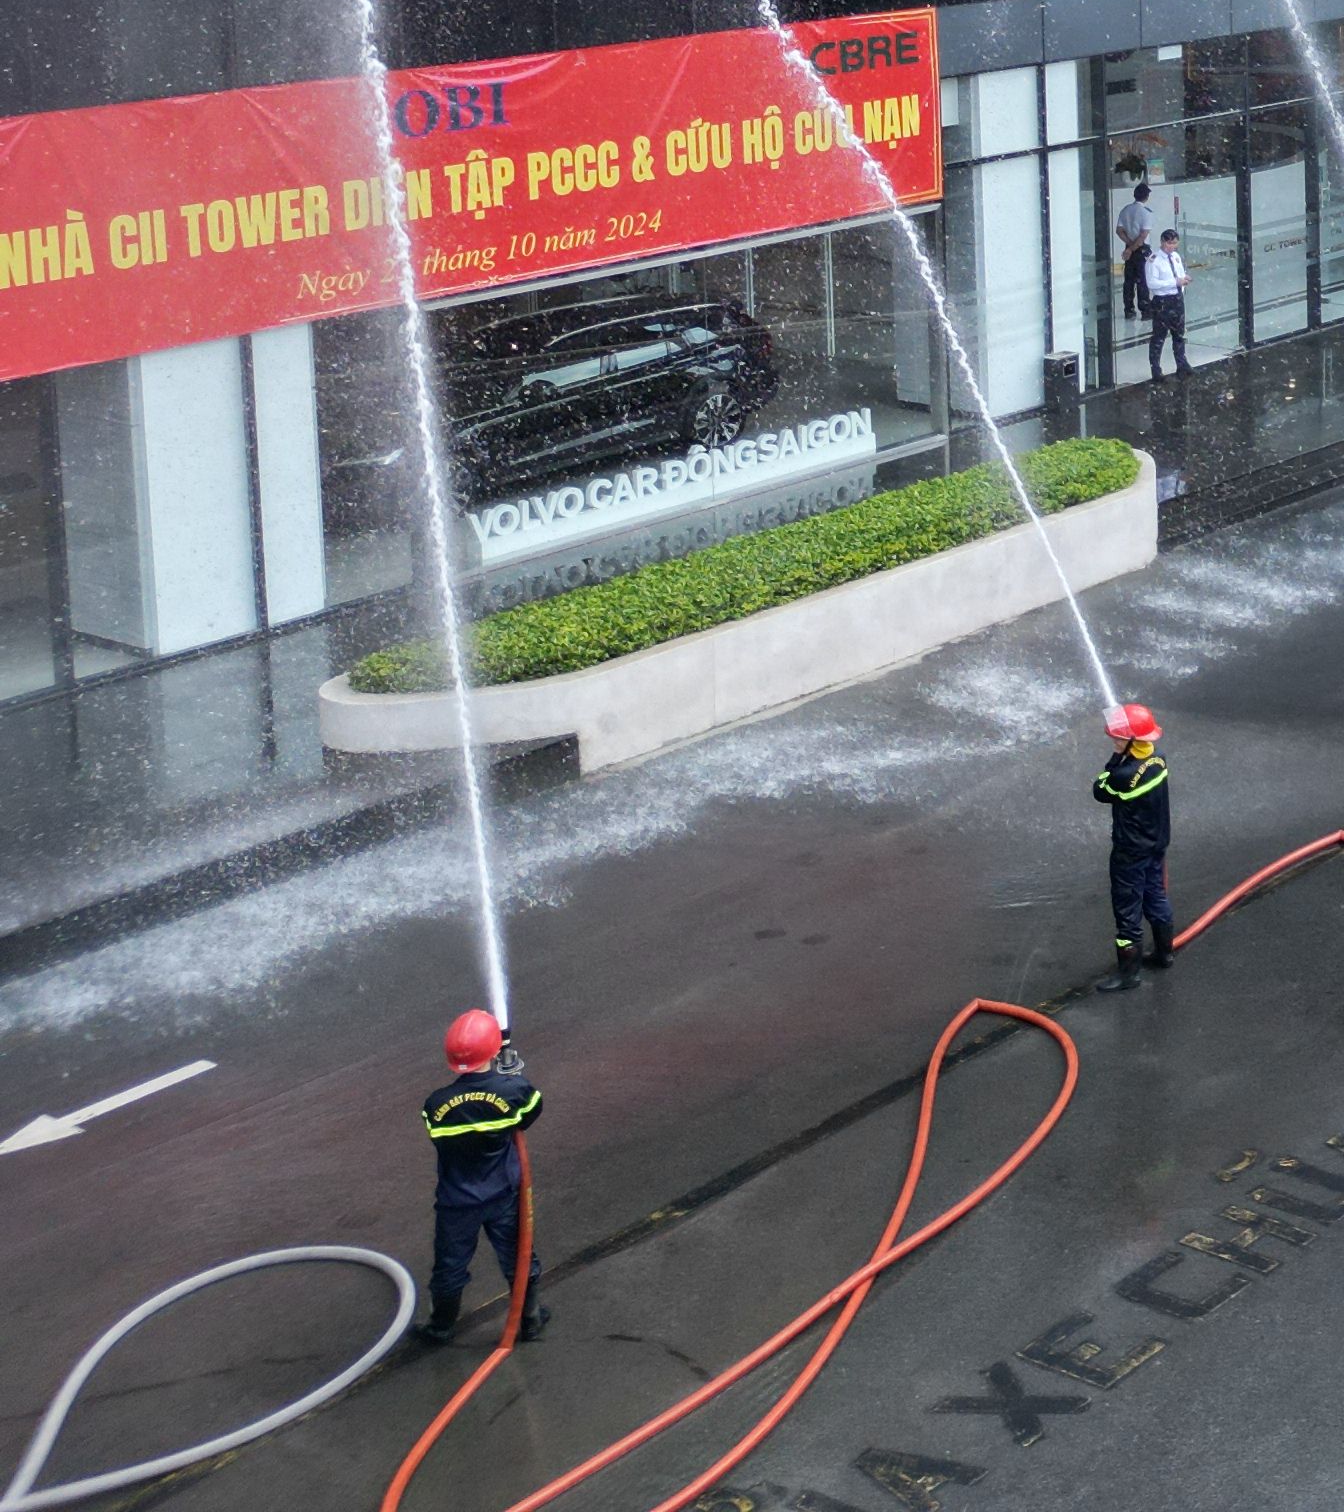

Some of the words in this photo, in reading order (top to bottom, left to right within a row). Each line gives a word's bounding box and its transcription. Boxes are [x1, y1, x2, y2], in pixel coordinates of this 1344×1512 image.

[811, 32, 919, 76] CBRE
[0, 208, 95, 288] NHÀ
[109, 209, 168, 269] CII
[180, 185, 330, 259] TOWER
[342, 168, 432, 232] DIN
[445, 149, 515, 220] TẬP
[527, 144, 621, 201] PCCC
[631, 136, 656, 183] &
[666, 118, 733, 176] CỨU
[743, 104, 784, 169] HỘ
[863, 94, 921, 150] NẠN
[297, 266, 371, 300] Ngày
[422, 245, 498, 276] tháng
[508, 233, 537, 261] 10
[544, 226, 597, 254] năm
[604, 209, 662, 243] 2024
[468, 486, 585, 544] VOLVO
[584, 467, 660, 511] CAR
[660, 443, 758, 490] ĐÔNG
[756, 407, 873, 464] SAIGON
[930, 1308, 1170, 1449] XE
